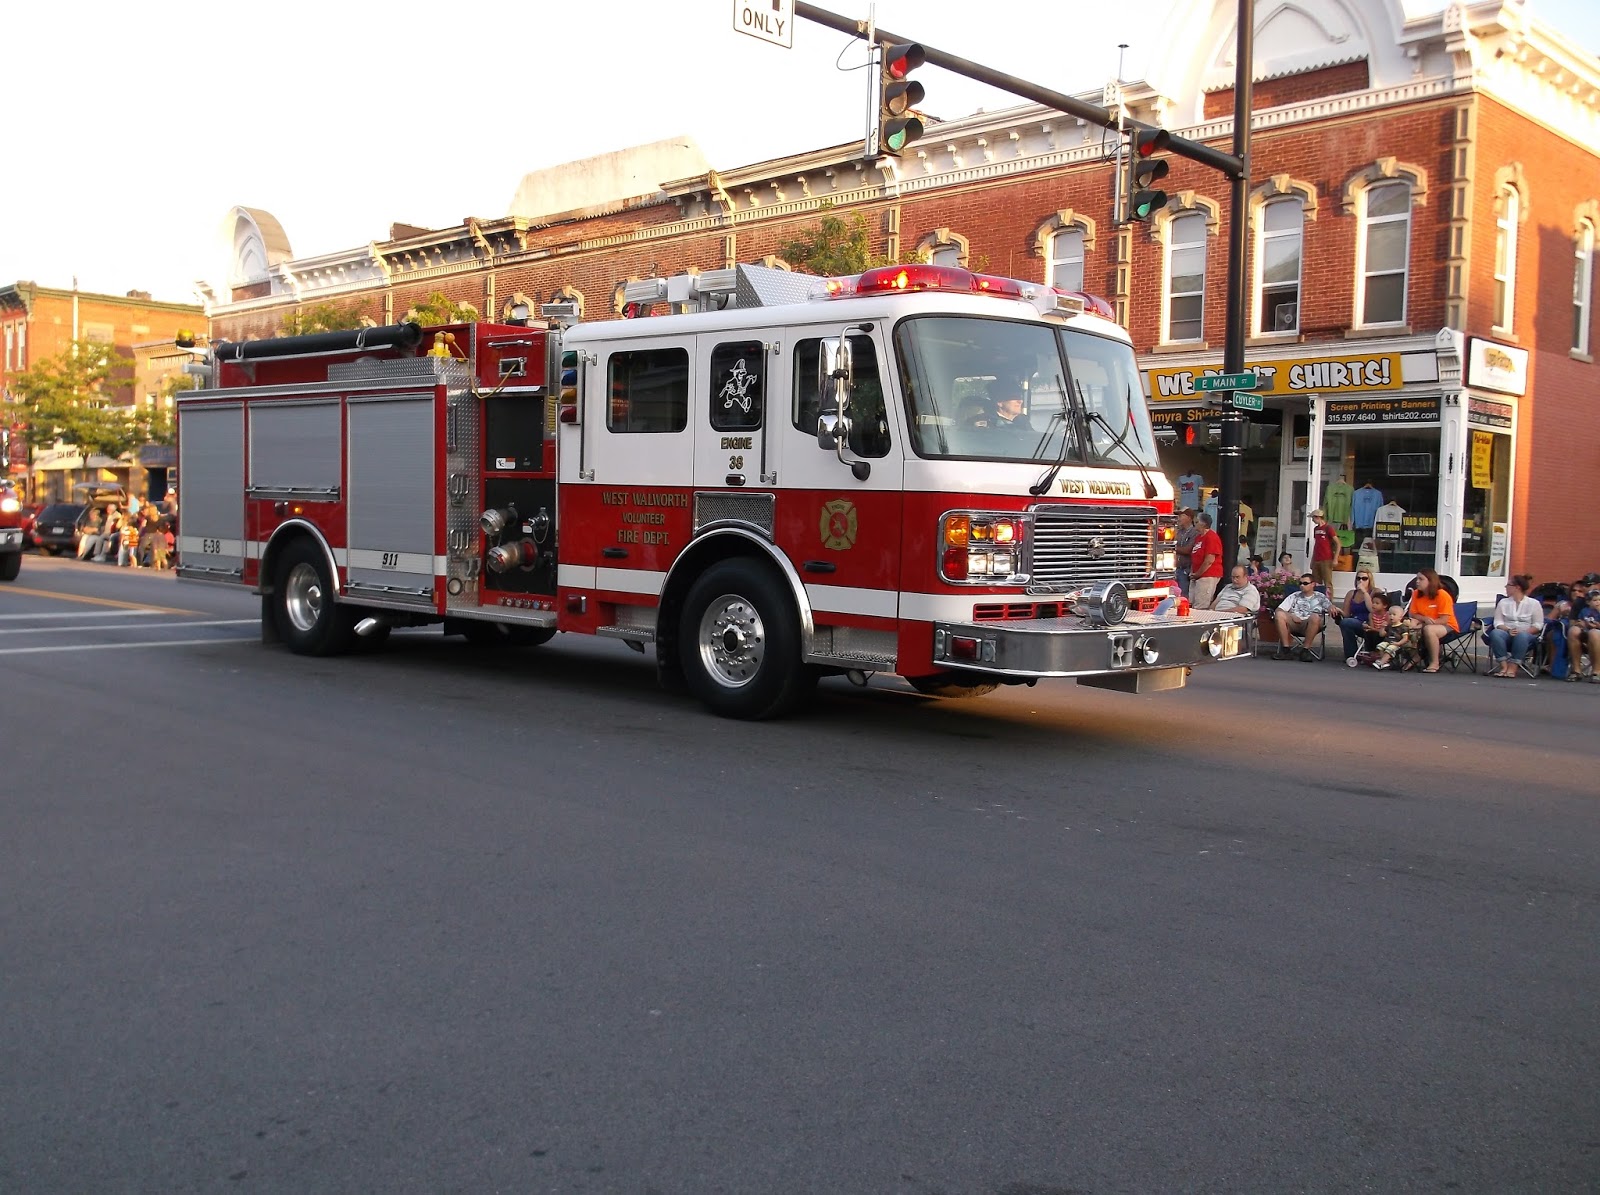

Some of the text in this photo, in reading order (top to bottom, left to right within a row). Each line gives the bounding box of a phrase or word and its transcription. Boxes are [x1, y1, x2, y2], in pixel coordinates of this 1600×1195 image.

[743, 7, 785, 37] ONLY
[1157, 358, 1391, 396] WE SHIRTS!
[1202, 380, 1207, 388] E
[1213, 378, 1236, 387] MAIN
[1235, 394, 1256, 406] CUYLER
[1330, 401, 1436, 412] Screen Printing Banners
[1328, 411, 1438, 422] 315.597.4640 tshirts202.com
[721, 437, 752, 450] ENGINE
[729, 456, 744, 470] 38
[1059, 479, 1131, 495] WEST WALWORTH
[603, 492, 688, 507] WEST WALWORTH
[622, 513, 665, 525] VOLUNTEER
[1403, 517, 1437, 526] YARD SIGNS
[617, 530, 670, 545] FIRE DEPT.
[203, 539, 220, 554] E-38
[382, 553, 398, 566] 911
